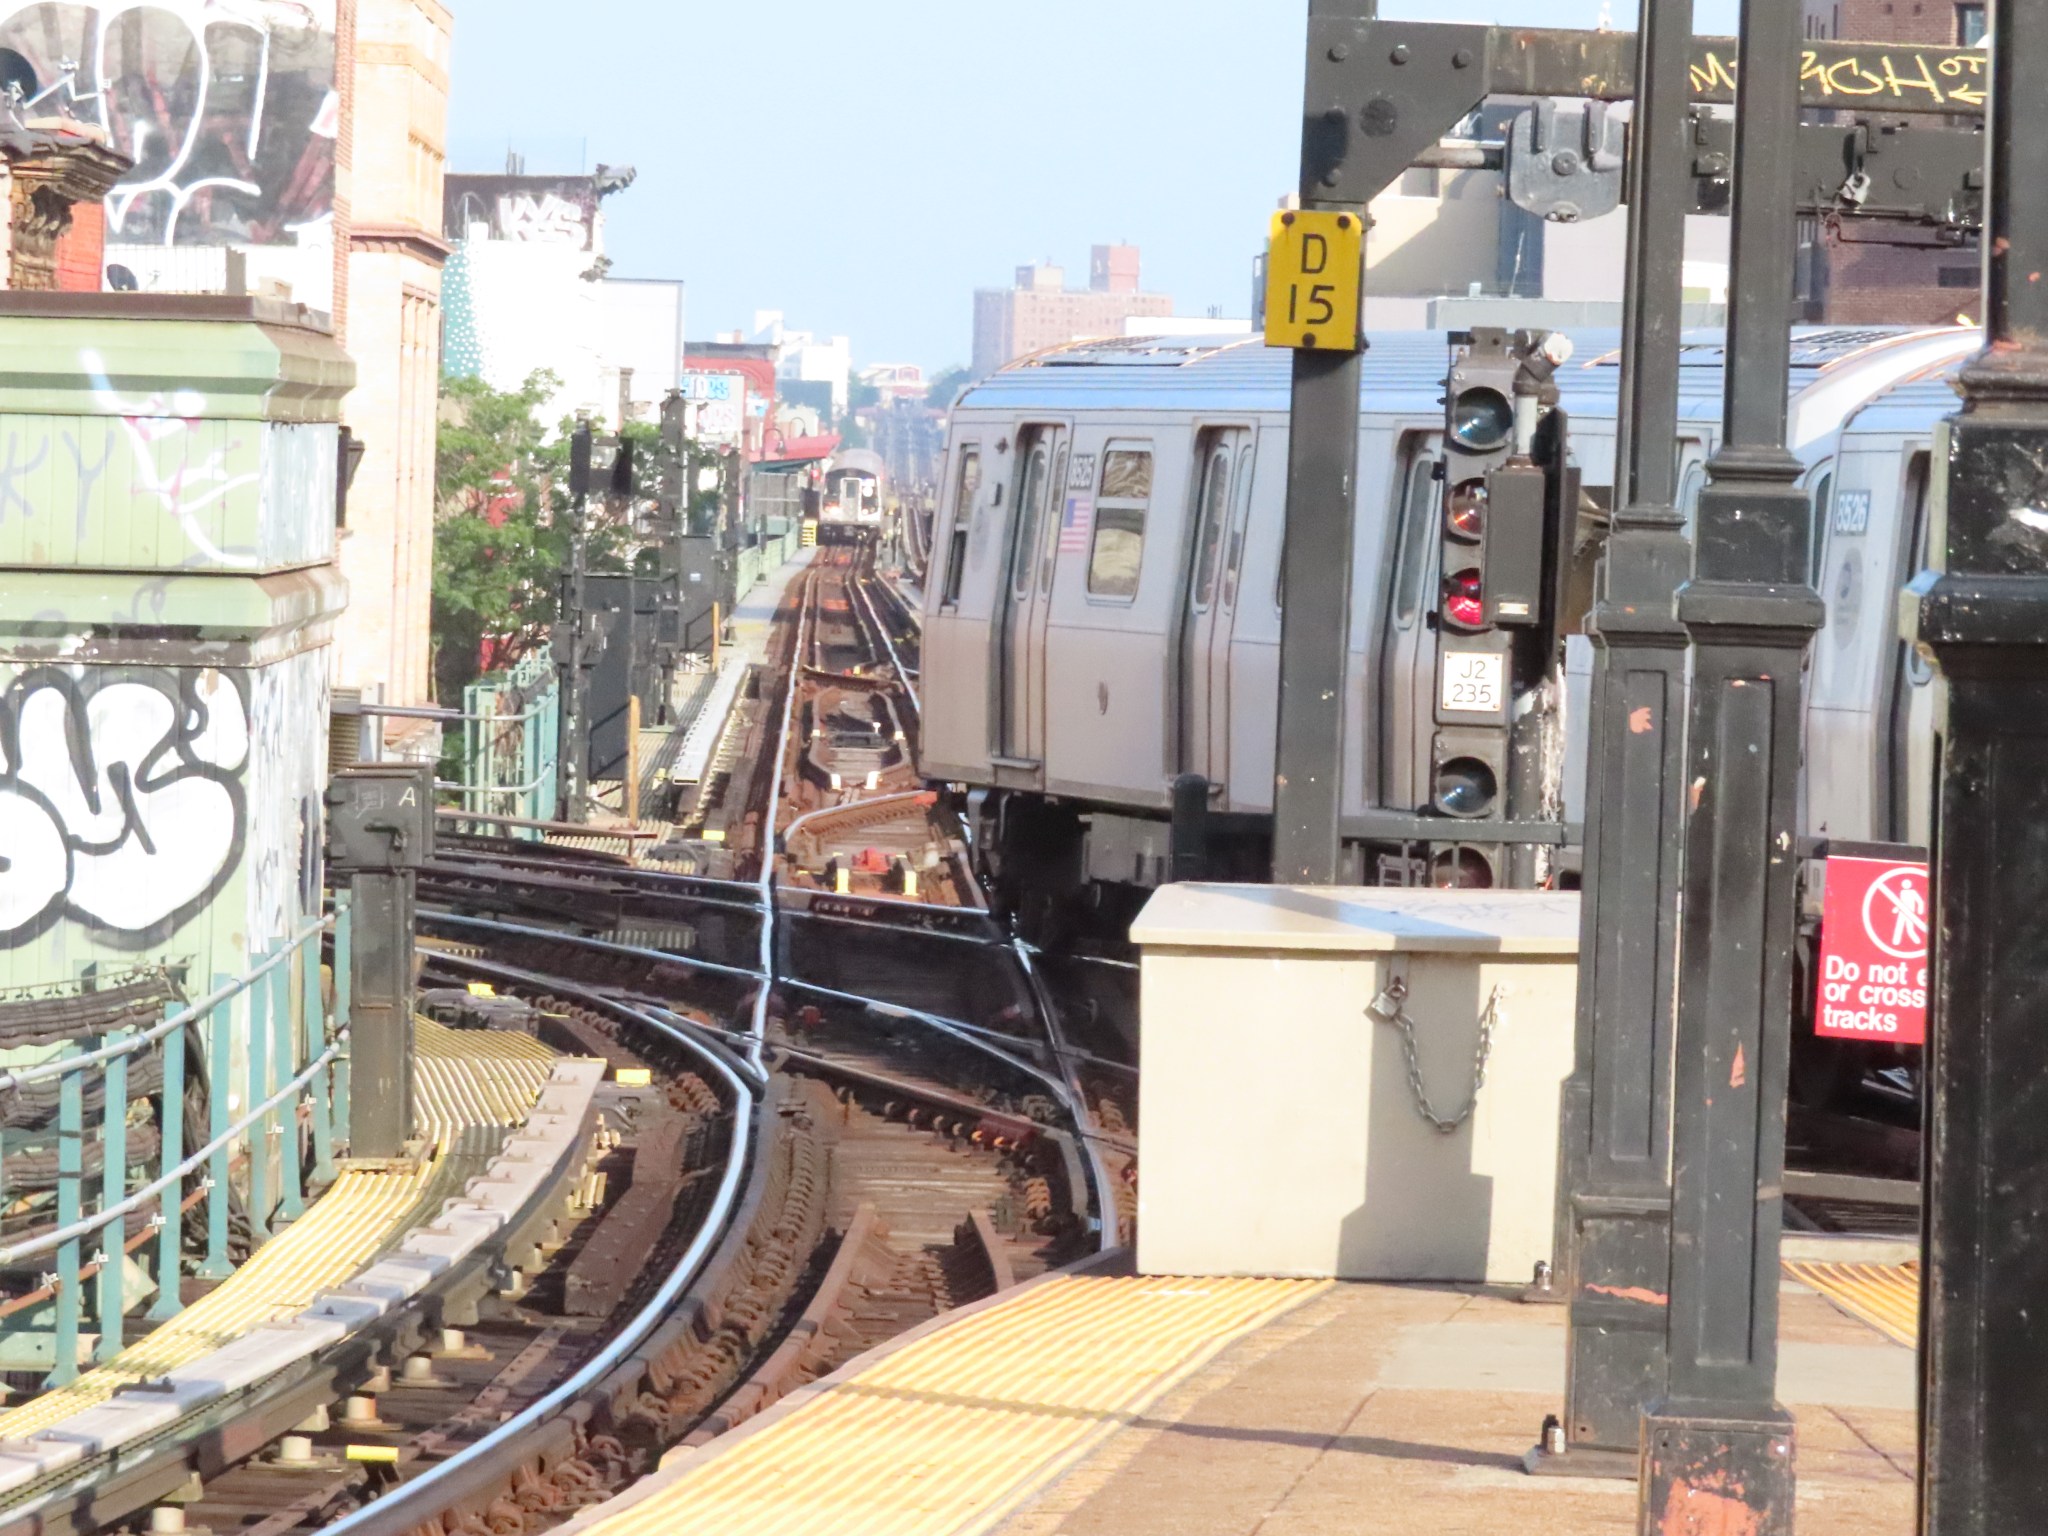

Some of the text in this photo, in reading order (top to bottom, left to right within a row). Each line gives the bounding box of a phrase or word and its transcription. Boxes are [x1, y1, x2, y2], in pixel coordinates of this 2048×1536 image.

[1301, 233, 1328, 275] D
[1289, 284, 1335, 325] 15
[1836, 494, 1869, 532] 8526
[1460, 660, 1487, 680] J2
[1452, 683, 1492, 704] 235
[398, 786, 416, 807] A
[1825, 955, 1861, 981] Do
[1868, 962, 1909, 986] not
[1824, 982, 1927, 1009] or cross
[1823, 1003, 1898, 1033] tracks
